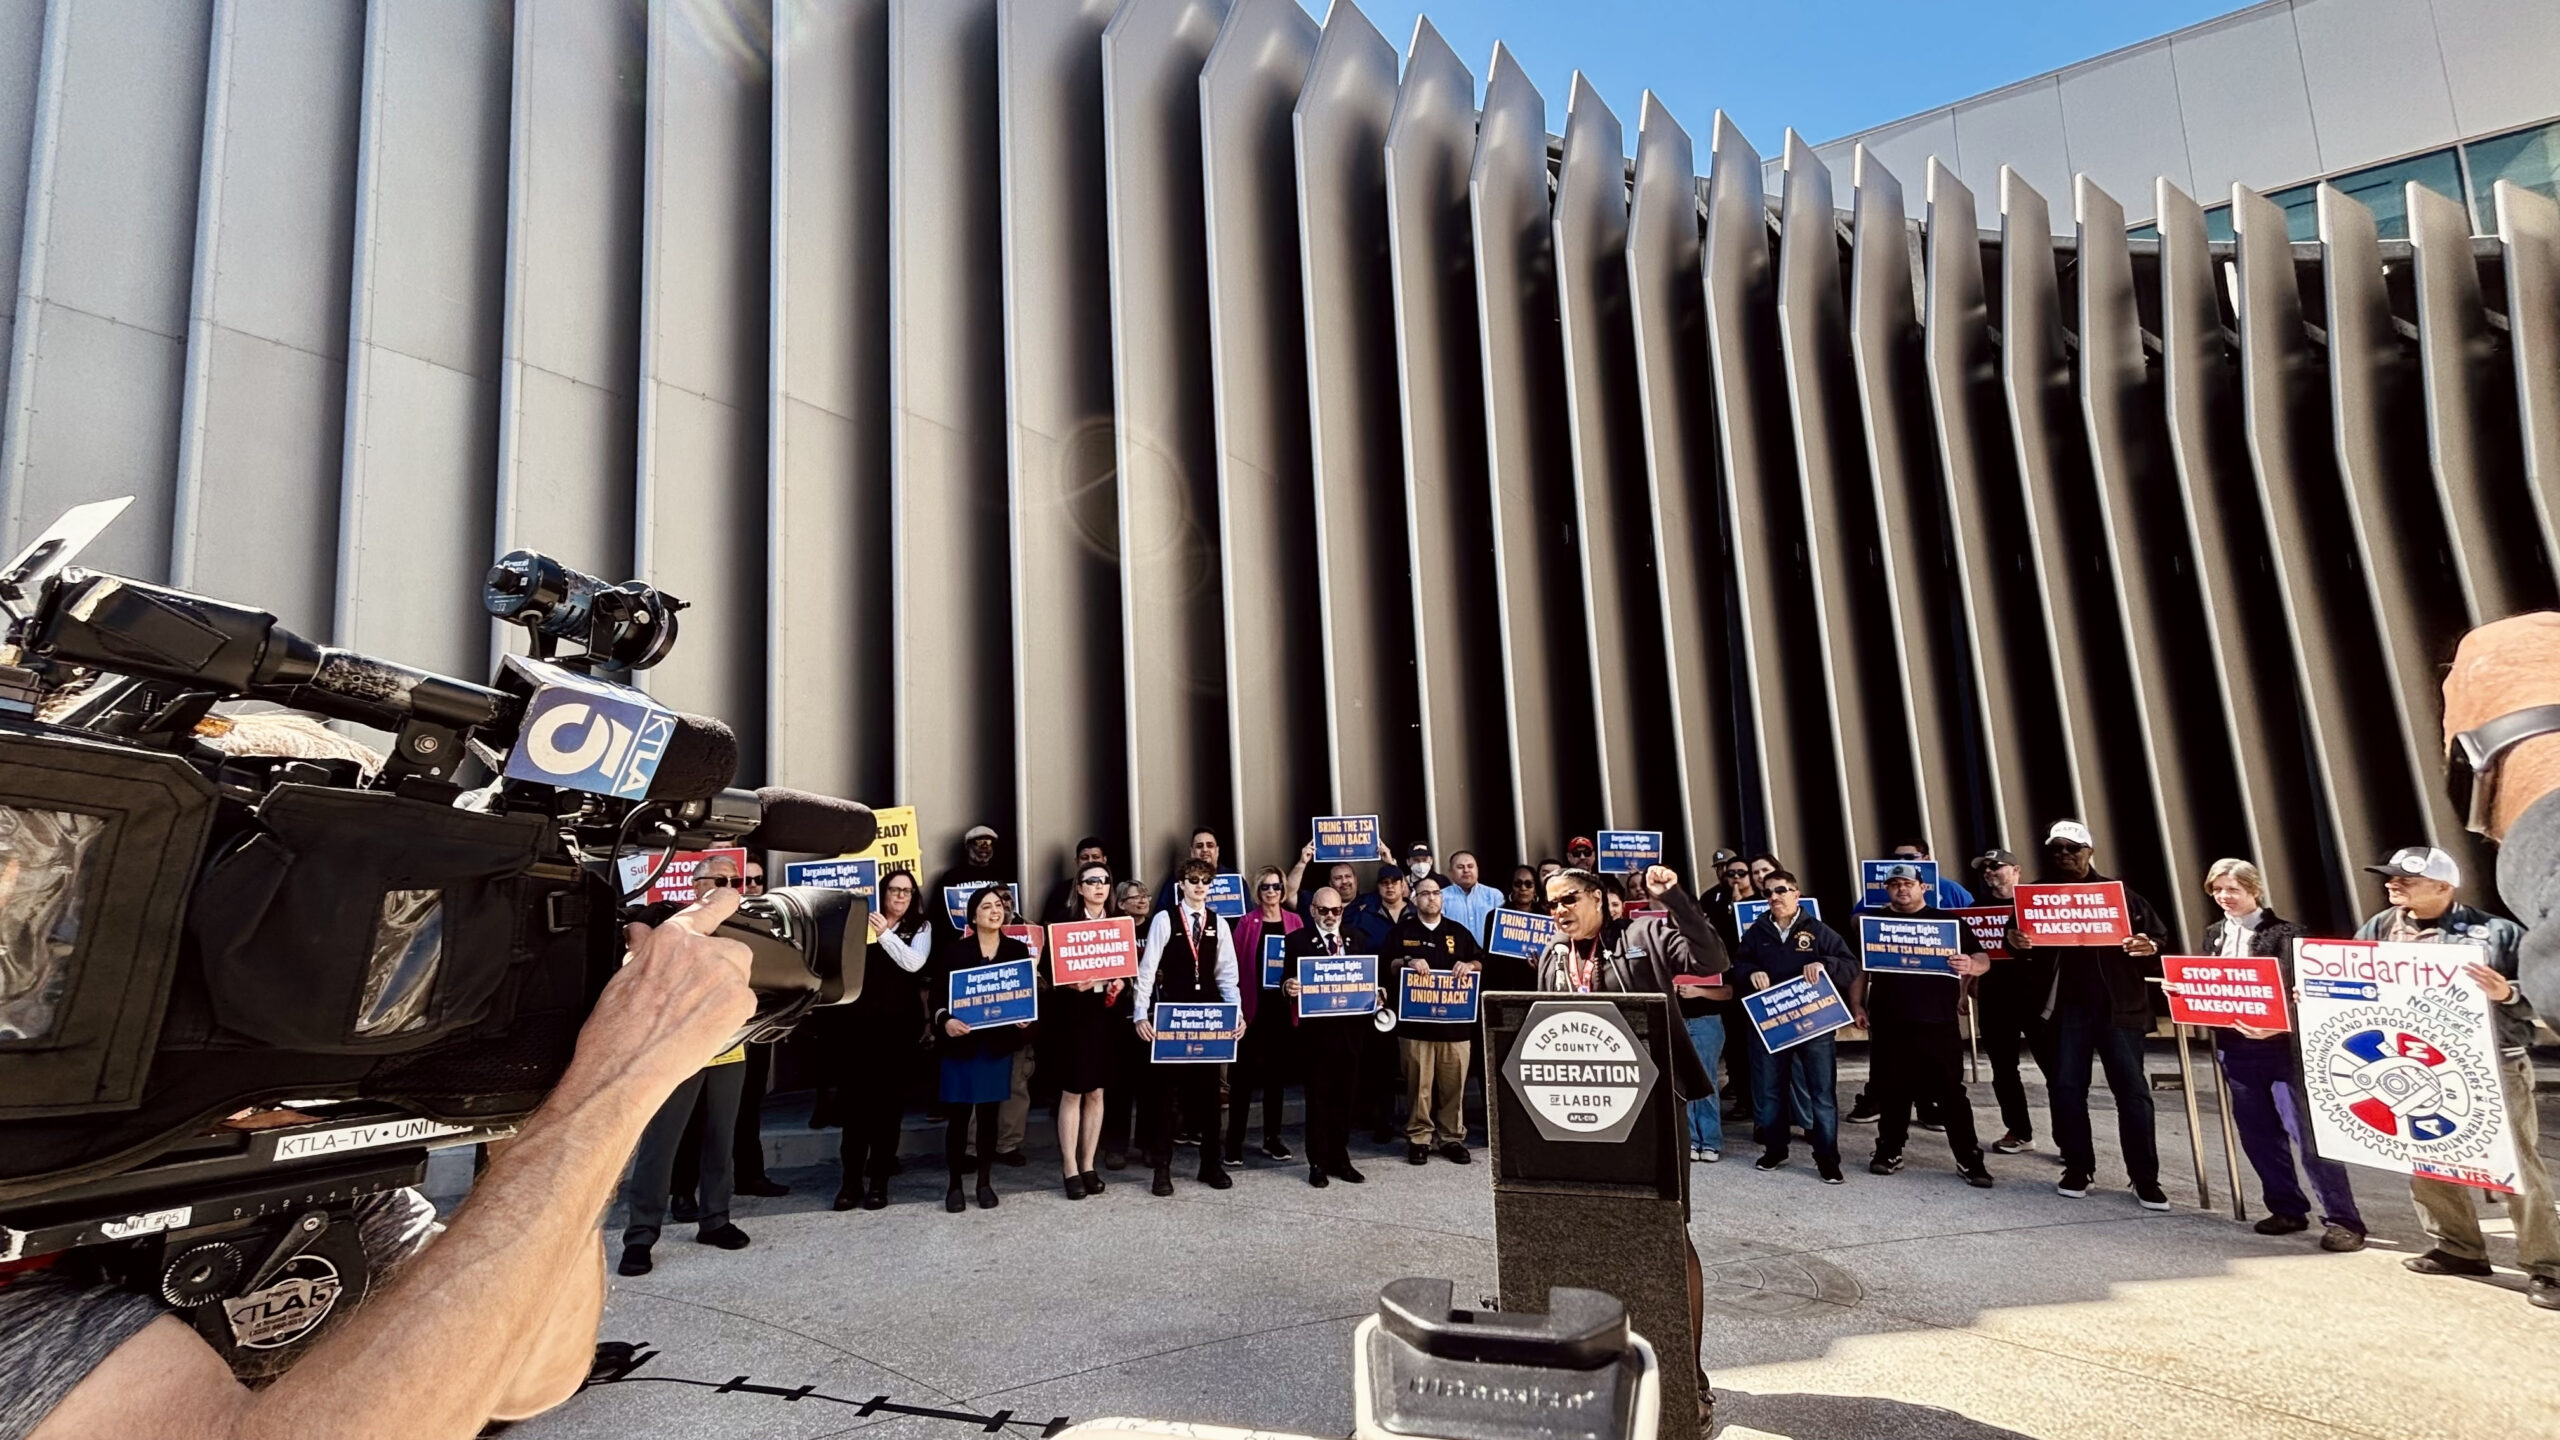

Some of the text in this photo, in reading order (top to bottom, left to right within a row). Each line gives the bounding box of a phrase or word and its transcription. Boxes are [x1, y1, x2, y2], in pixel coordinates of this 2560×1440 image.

[619, 714, 675, 793] KTLA
[876, 824, 908, 839] EADY
[1318, 820, 1374, 833] BRING THE TSA
[1322, 833, 1371, 845] UNION BACK!
[882, 843, 899, 857] TO
[802, 865, 858, 878] Bargaining Rights
[878, 859, 916, 876] TRIKE!
[812, 878, 838, 887] Workers
[839, 876, 860, 888] Rights
[661, 889, 696, 901] TAKE
[2032, 893, 2105, 906] STOP THE
[2024, 907, 2119, 920] BILLIONAIRE
[1500, 913, 1528, 929] BRING
[1529, 917, 1548, 931] THE
[1880, 922, 1939, 935] Bargaining Rights
[2032, 922, 2113, 934] TAKEOVER
[1067, 928, 1120, 943] STOP THE
[1502, 927, 1552, 945] UNION BAC
[1879, 933, 1941, 947] Are Workers Rights
[1059, 941, 1130, 958] BILLIONAIRE
[1901, 945, 1913, 954] TSA
[1066, 955, 1125, 971] TAKEOVER
[1315, 960, 1362, 972] Bargaining Rights
[2300, 943, 2459, 988] Solidarity
[967, 967, 1018, 984] Bargaining Rights
[1313, 972, 1363, 983] Are Workers Rights
[1407, 973, 1435, 988] BRING
[1437, 974, 1454, 989] THE
[2181, 967, 2258, 981] STOP THE
[965, 979, 1020, 995] Are Workers Rights
[2175, 983, 2274, 999] BILLIONAIRE
[2445, 984, 2469, 1003] NO
[1410, 988, 1468, 1005] UNION BACK!
[1761, 988, 1795, 1006] Bargaining
[1766, 990, 1820, 1017] Are Workers Rights
[2407, 995, 2431, 1014] NO
[1172, 1008, 1222, 1019] Bargaining Rights
[2185, 998, 2268, 1015] TAKEOVER
[1170, 1020, 1223, 1031] Are Workers Rights
[1535, 1022, 1621, 1053] LOS ANGELES
[1555, 1042, 1599, 1053] COUNTY
[2317, 1017, 2483, 1101] OF MACHINISTS AND AEROSPACE WORKERS
[1520, 1064, 1640, 1083] FEDERATION
[1550, 1094, 1612, 1107] OF LABOR
[1569, 1114, 1596, 1122] AFL-CIO
[2332, 1102, 2486, 1154] INTERNATIONAL ASSOCIATION
[281, 1128, 378, 1157] KTLA-TV
[110, 1211, 179, 1234] UNIT #05
